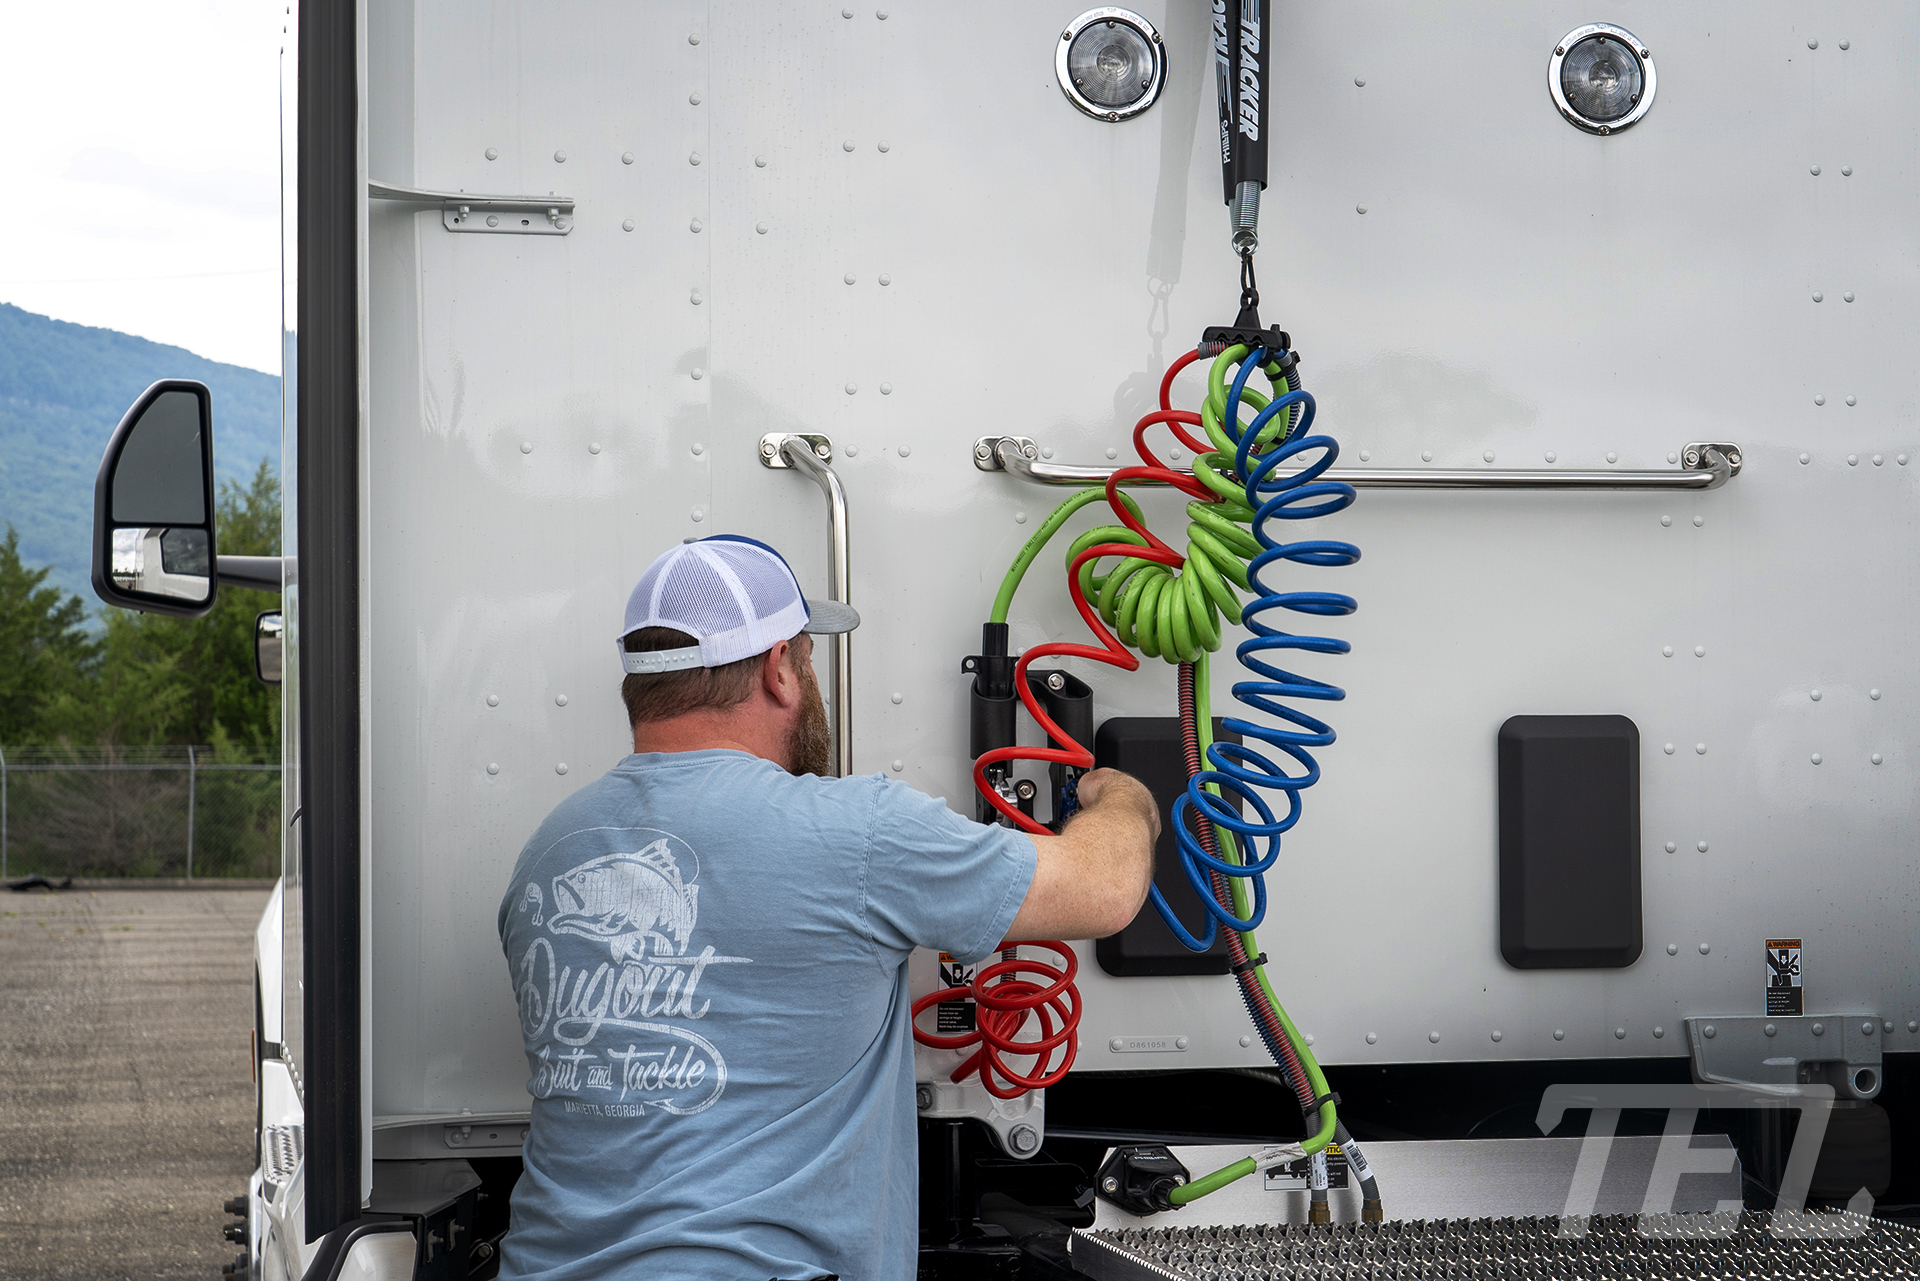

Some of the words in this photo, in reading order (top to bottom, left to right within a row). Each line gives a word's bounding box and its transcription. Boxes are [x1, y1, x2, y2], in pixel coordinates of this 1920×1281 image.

[1240, 17, 1261, 142] TRACKER
[519, 937, 753, 1046] Dugout
[586, 1062, 614, 1090] and
[607, 1043, 706, 1103] Tackle
[1129, 1041, 1167, 1049] D861058
[564, 1100, 604, 1118] MARIETTA,
[604, 1104, 645, 1117] GEORGIA
